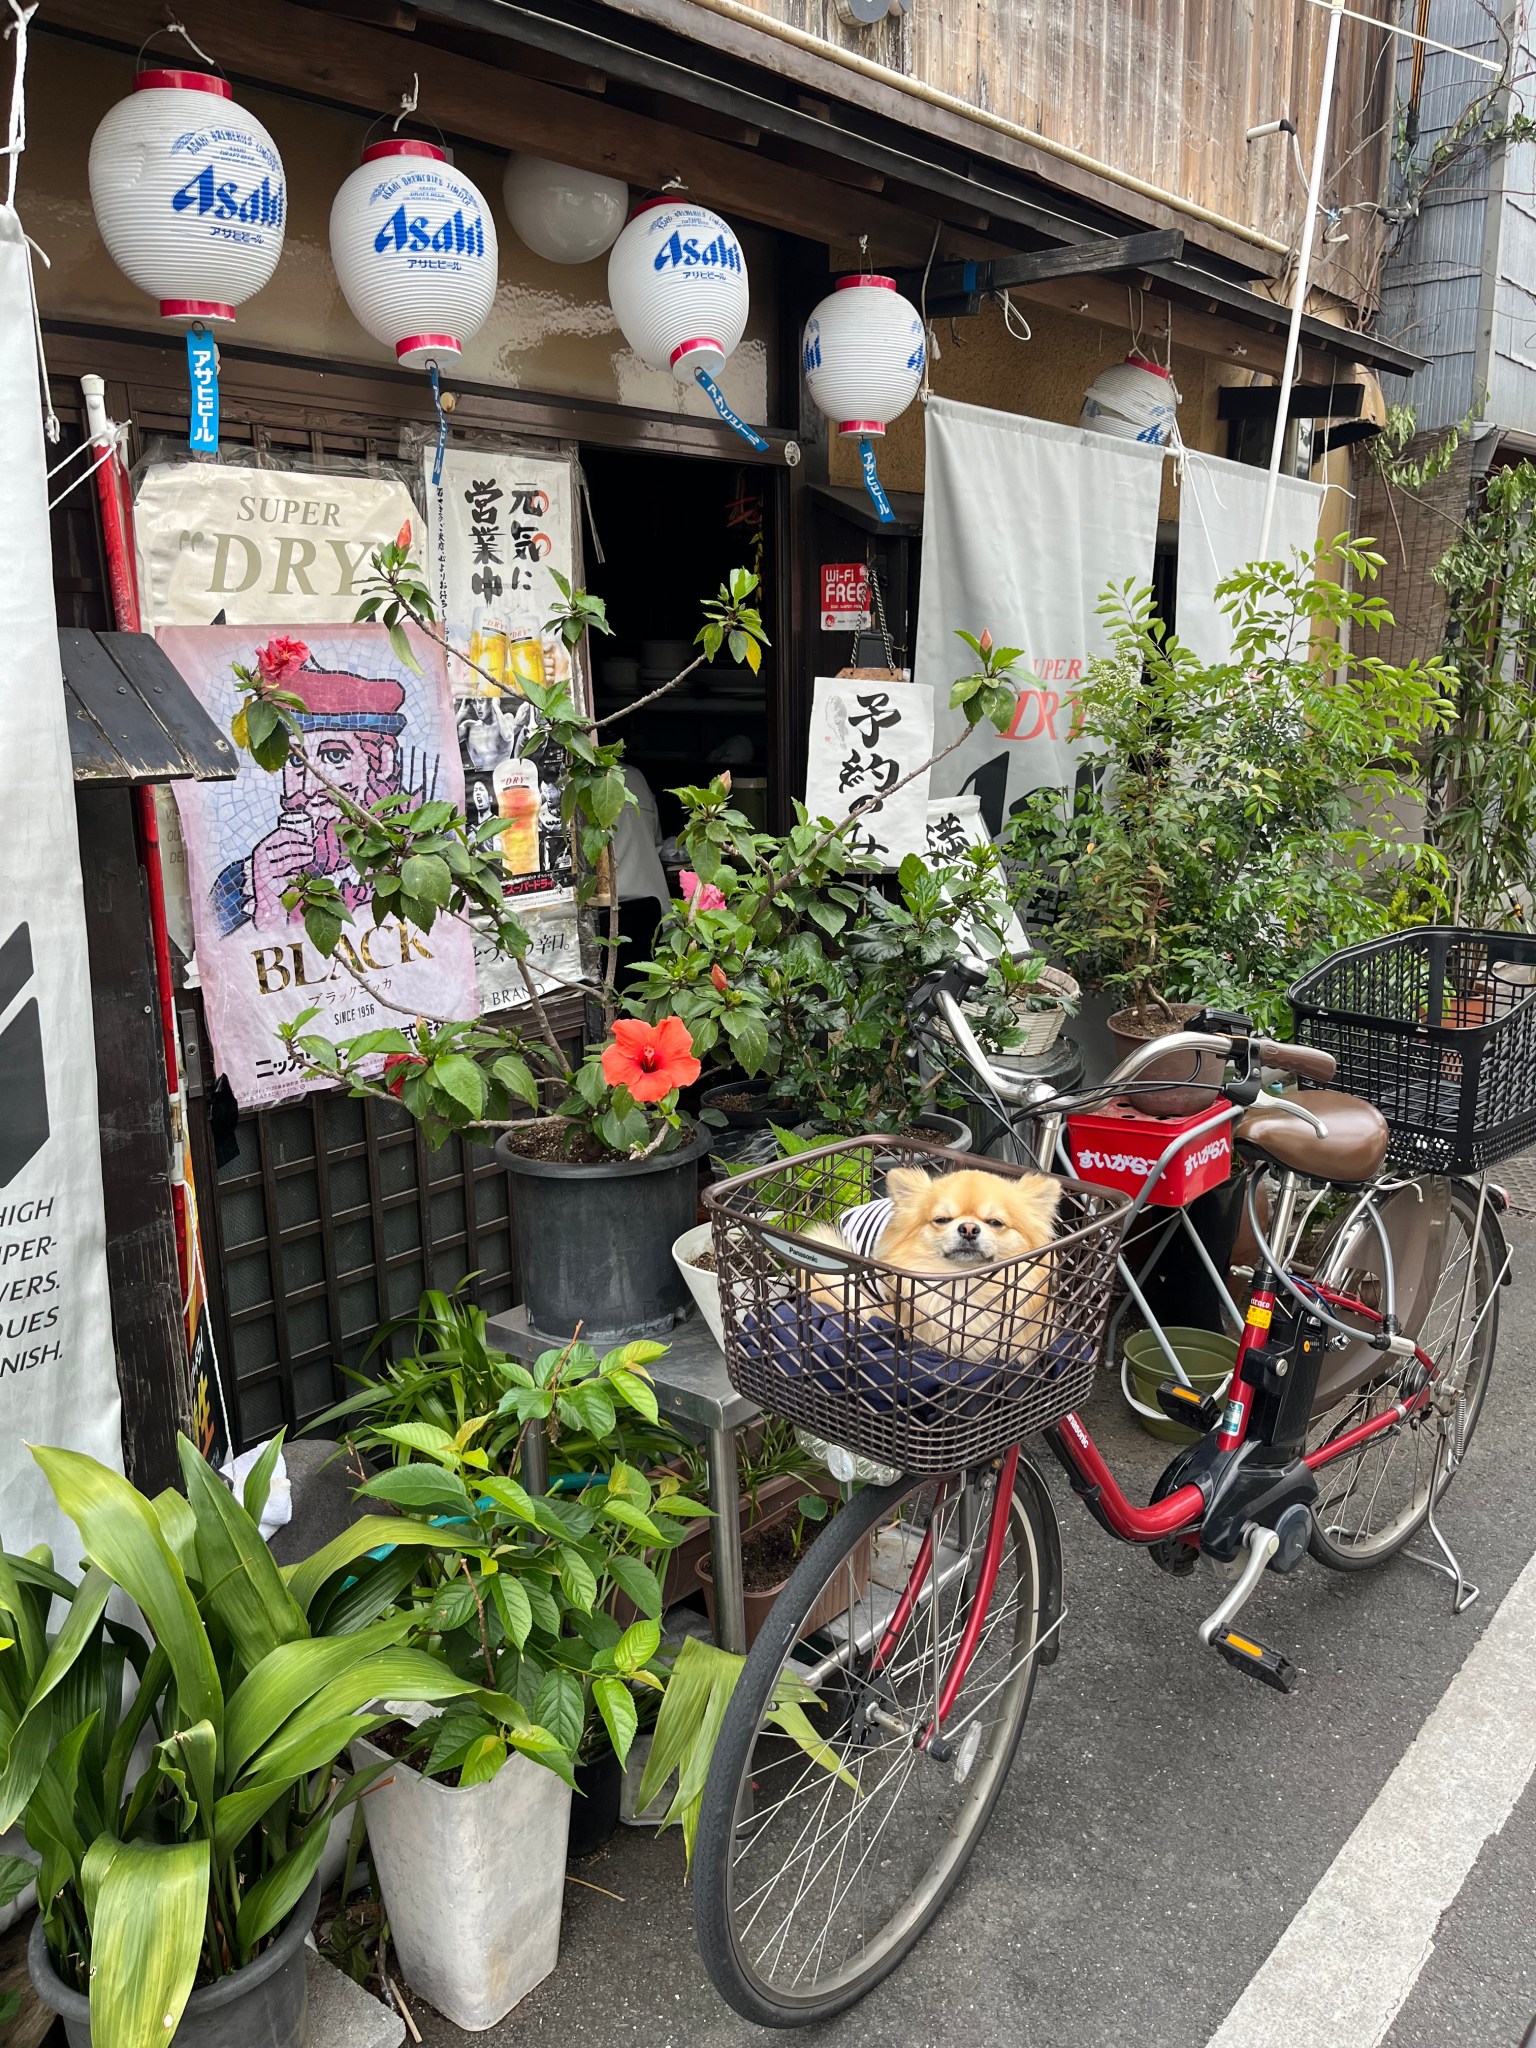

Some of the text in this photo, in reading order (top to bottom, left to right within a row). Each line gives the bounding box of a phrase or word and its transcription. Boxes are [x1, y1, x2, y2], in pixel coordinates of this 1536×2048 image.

[172, 163, 285, 228] Asahi
[209, 226, 264, 244] アサヒビール
[374, 203, 486, 258] Asahi
[407, 258, 462, 272] アサヒビール
[654, 230, 742, 276] Asahi
[192, 350, 215, 443] アサヒビール
[706, 383, 760, 446] アサヒビール
[864, 452, 890, 516] アサヒビール
[236, 496, 342, 527] SUPER
[464, 478, 506, 607] 営業中
[508, 482, 549, 591] 元気に
[825, 569, 854, 582] Wi-Fi
[825, 582, 867, 603] FREE
[838, 692, 902, 856] 予約のみ
[250, 922, 435, 996] BLACK
[308, 978, 393, 1008] ブラックニッカ
[334, 1003, 376, 1026] SINCE 1956
[1184, 1136, 1230, 1176] すいがら入
[0, 1235, 58, 1266] PER-
[788, 1246, 818, 1263] Panasonic
[0, 1306, 60, 1340] UES
